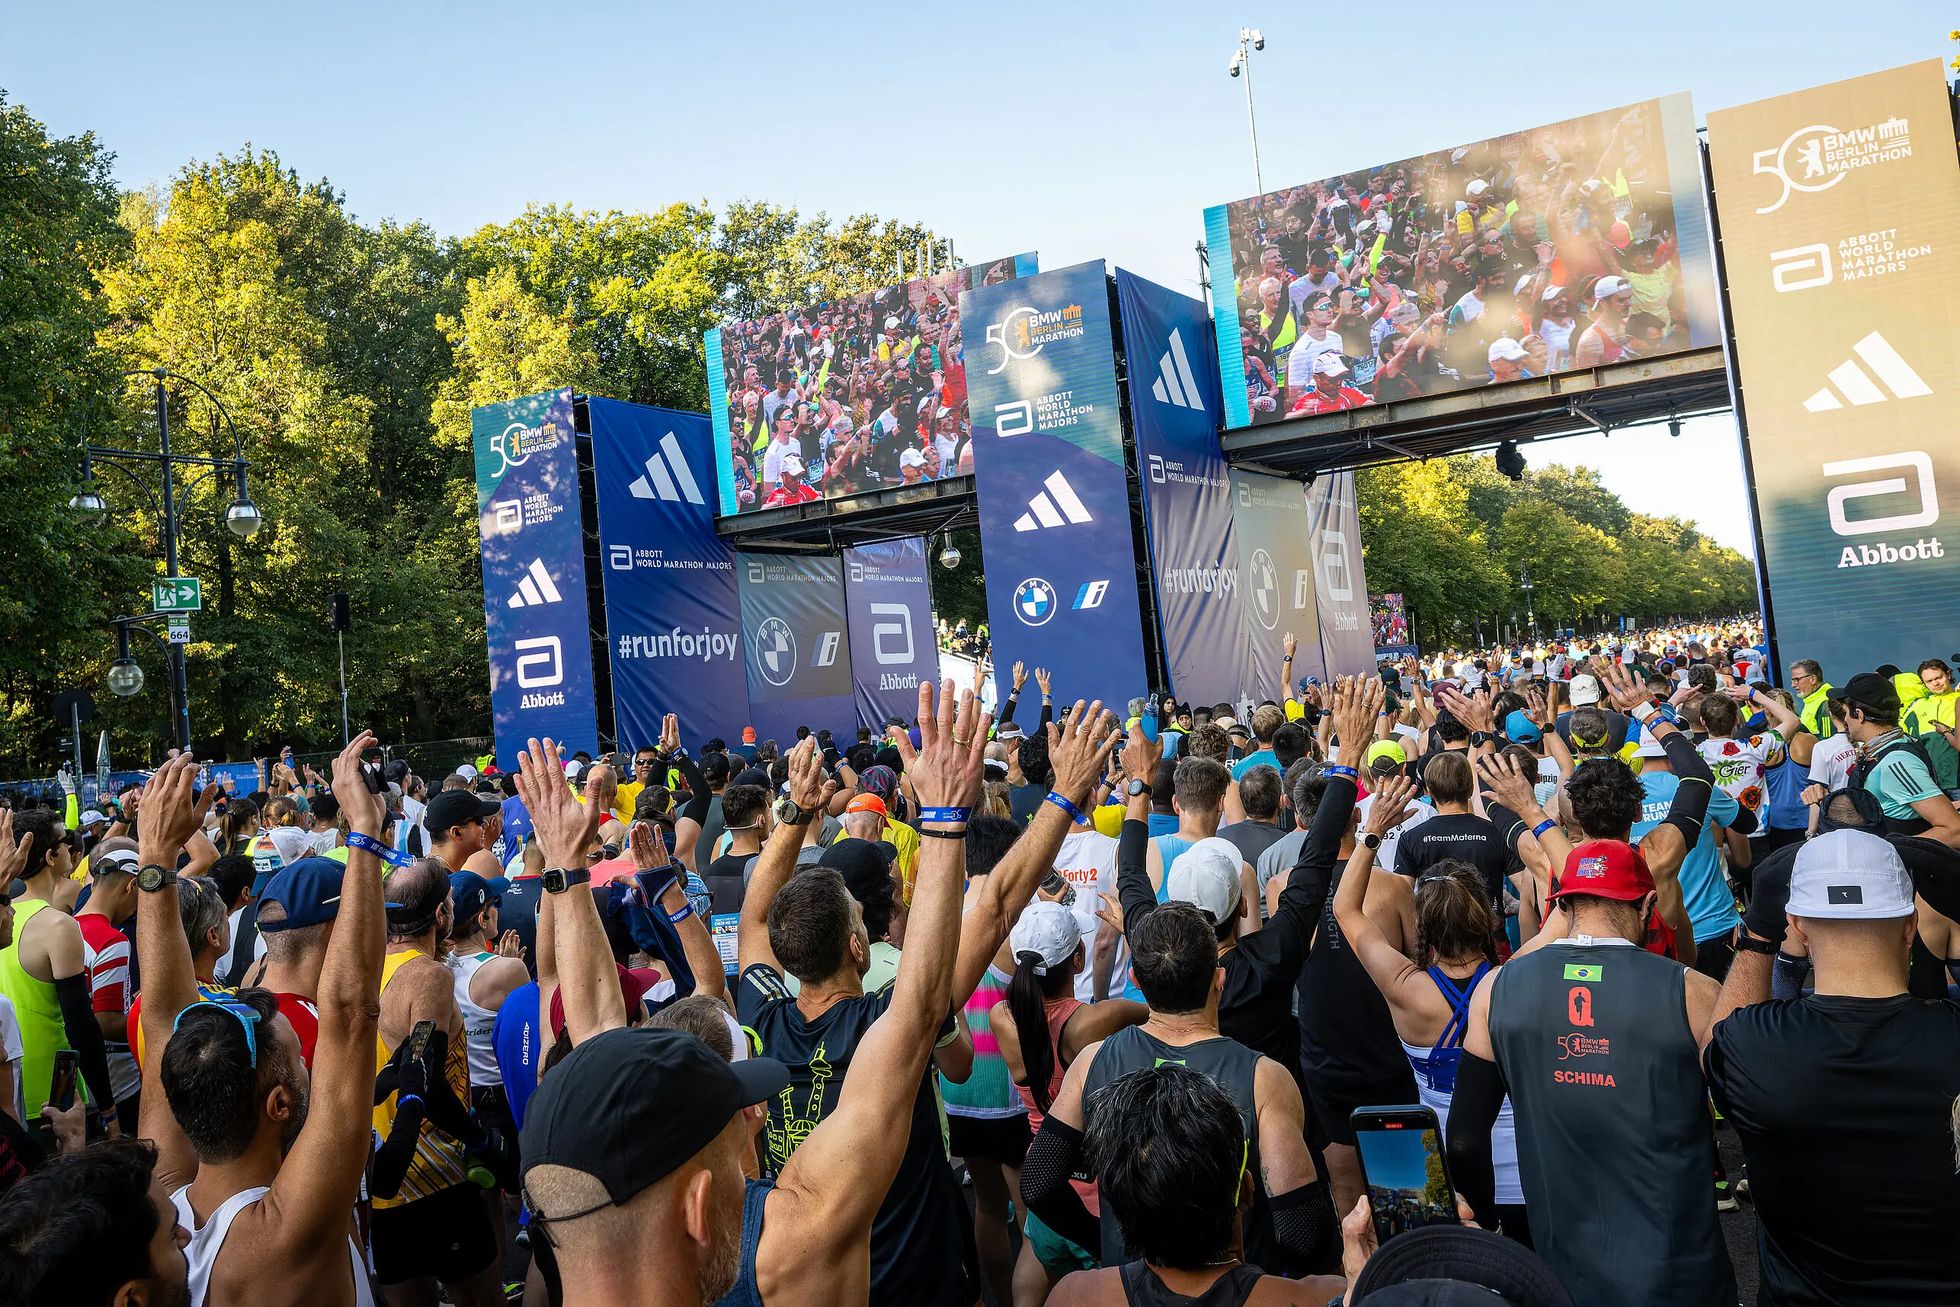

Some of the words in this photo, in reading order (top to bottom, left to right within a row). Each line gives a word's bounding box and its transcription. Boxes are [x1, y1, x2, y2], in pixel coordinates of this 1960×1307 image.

[1823, 126, 1875, 150] BMW
[1825, 141, 1878, 162] BERLIN
[1826, 146, 1912, 173] MARATHON
[1838, 229, 1896, 249] ABBOTT
[1839, 241, 1893, 259] WORLD
[1842, 245, 1931, 271] MARATHON
[1843, 261, 1906, 280] MAJORS
[1030, 310, 1062, 327] BMW
[1031, 322, 1064, 336] BERLIN
[1031, 327, 1084, 345] MARATHON
[1036, 391, 1072, 405] ABBOTT
[1037, 400, 1070, 413] WORLD
[1038, 404, 1093, 422] MARATHON
[1039, 416, 1078, 430] MAJORS
[520, 426, 542, 439] BMW
[521, 437, 544, 447] BERLIN
[521, 440, 557, 455] MARATHON
[1166, 461, 1183, 471] ABBOTT
[1167, 471, 1184, 482] WORLD
[524, 493, 549, 504] ABBOTT
[524, 501, 548, 511] WORLD
[525, 505, 563, 518] MARATHON
[526, 515, 552, 525] MAJORS
[635, 550, 663, 558] ABBOTT
[1837, 537, 1945, 568] Abbott
[636, 559, 661, 568] WORLD
[664, 561, 703, 569] MARATHON
[706, 561, 732, 570] MAJORS
[767, 573, 785, 581] WORLD
[1165, 560, 1238, 600] #runforjoy
[1018, 580, 1049, 596] BMW
[1334, 611, 1359, 631] Abbott
[170, 631, 188, 639] 664
[760, 621, 789, 640] BMW
[619, 626, 737, 662] #runforjoy
[880, 673, 918, 691] Abbott
[520, 691, 565, 709] Abbott
[1719, 763, 1751, 778] Gier
[1642, 801, 1672, 813] TEAM
[1643, 811, 1669, 821] RUN
[1423, 834, 1487, 843] #TeamMaterna
[1058, 868, 1098, 884] Forty2
[522, 1021, 530, 1066] ADIZERO
[1554, 1070, 1616, 1088] SCHIMA
